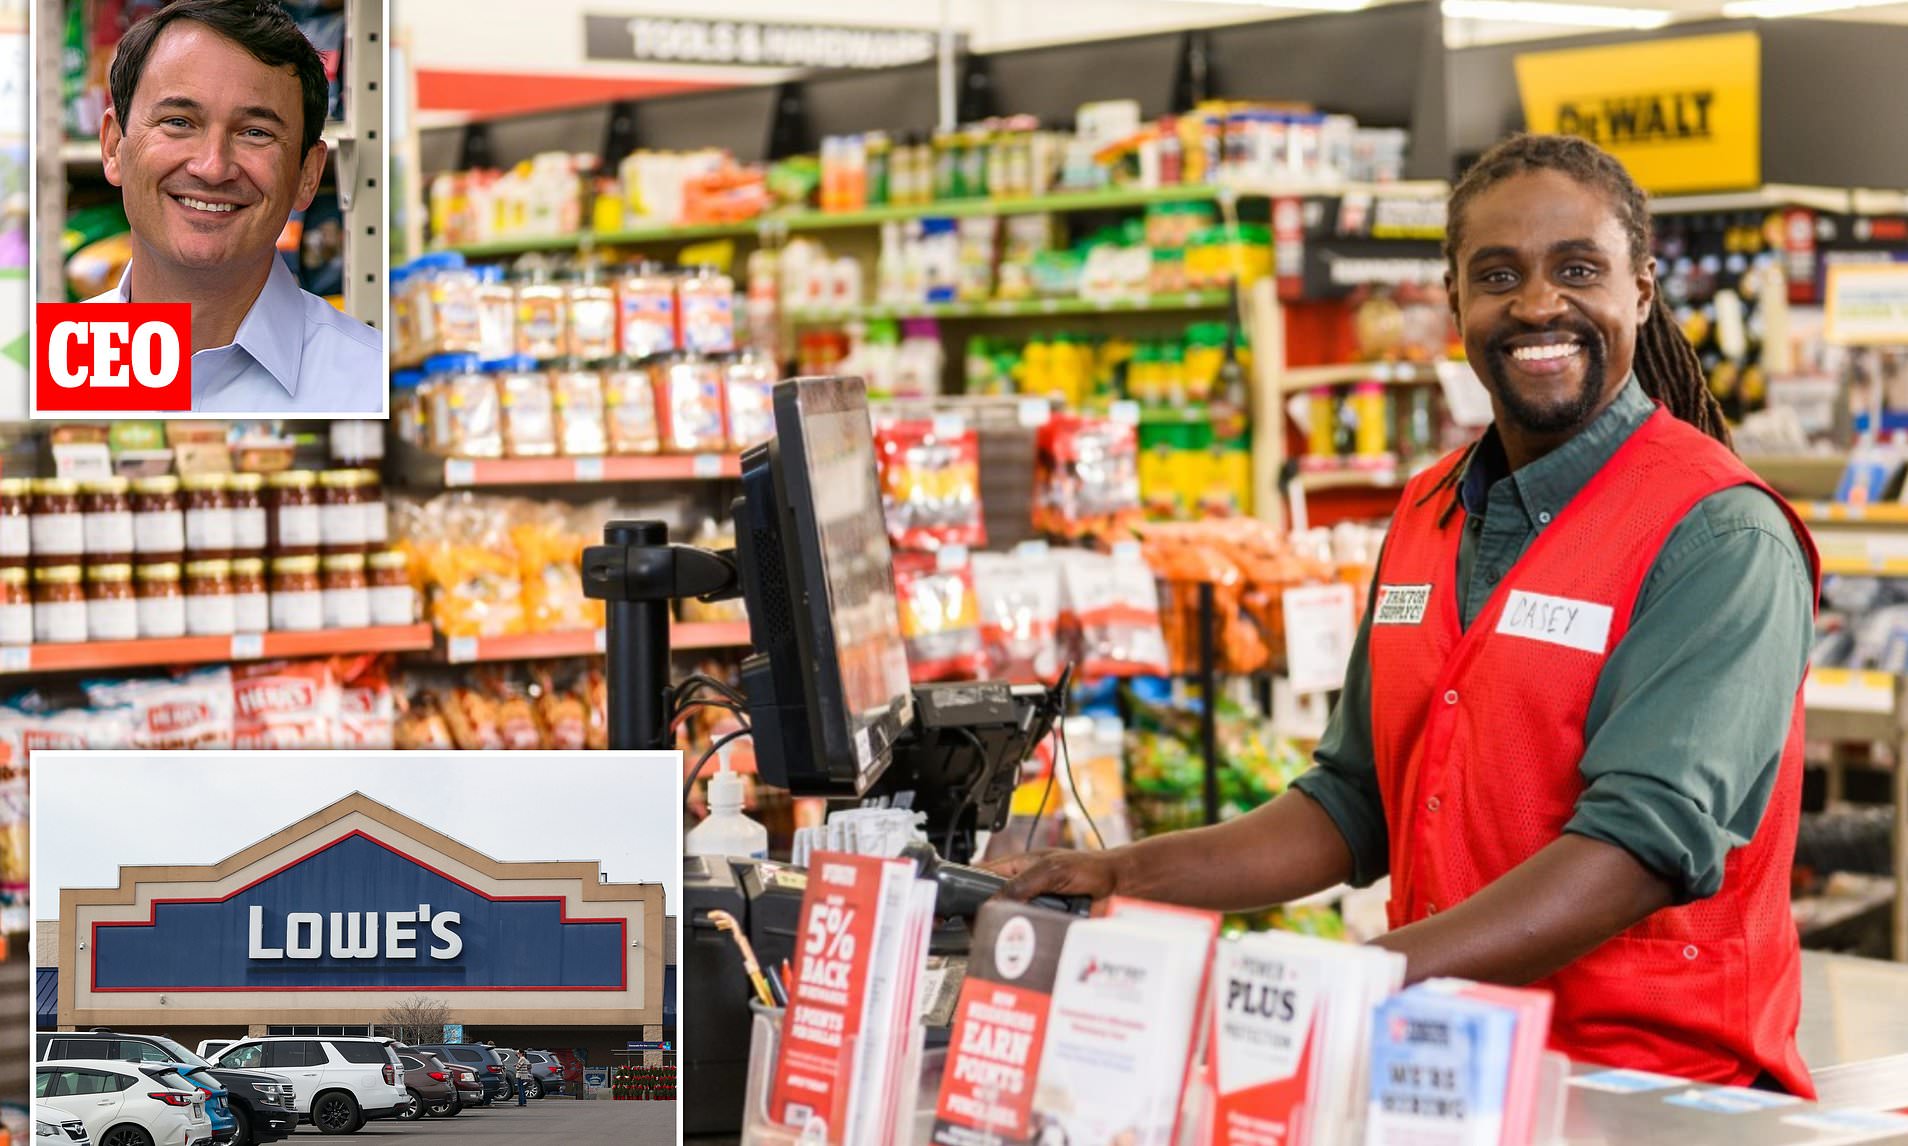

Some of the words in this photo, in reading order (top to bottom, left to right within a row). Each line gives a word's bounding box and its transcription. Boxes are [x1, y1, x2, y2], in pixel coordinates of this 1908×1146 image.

[628, 18, 735, 60] TOOLS
[1386, 590, 1427, 604] TRACTOR
[1510, 597, 1579, 634] CASEY
[249, 904, 463, 959] LOWE'S
[805, 902, 856, 961] 5%
[801, 955, 852, 990] BACK
[1227, 978, 1296, 1022] PLUS
[961, 1020, 1033, 1066] EARN
[954, 1055, 1025, 1094] POINTS
